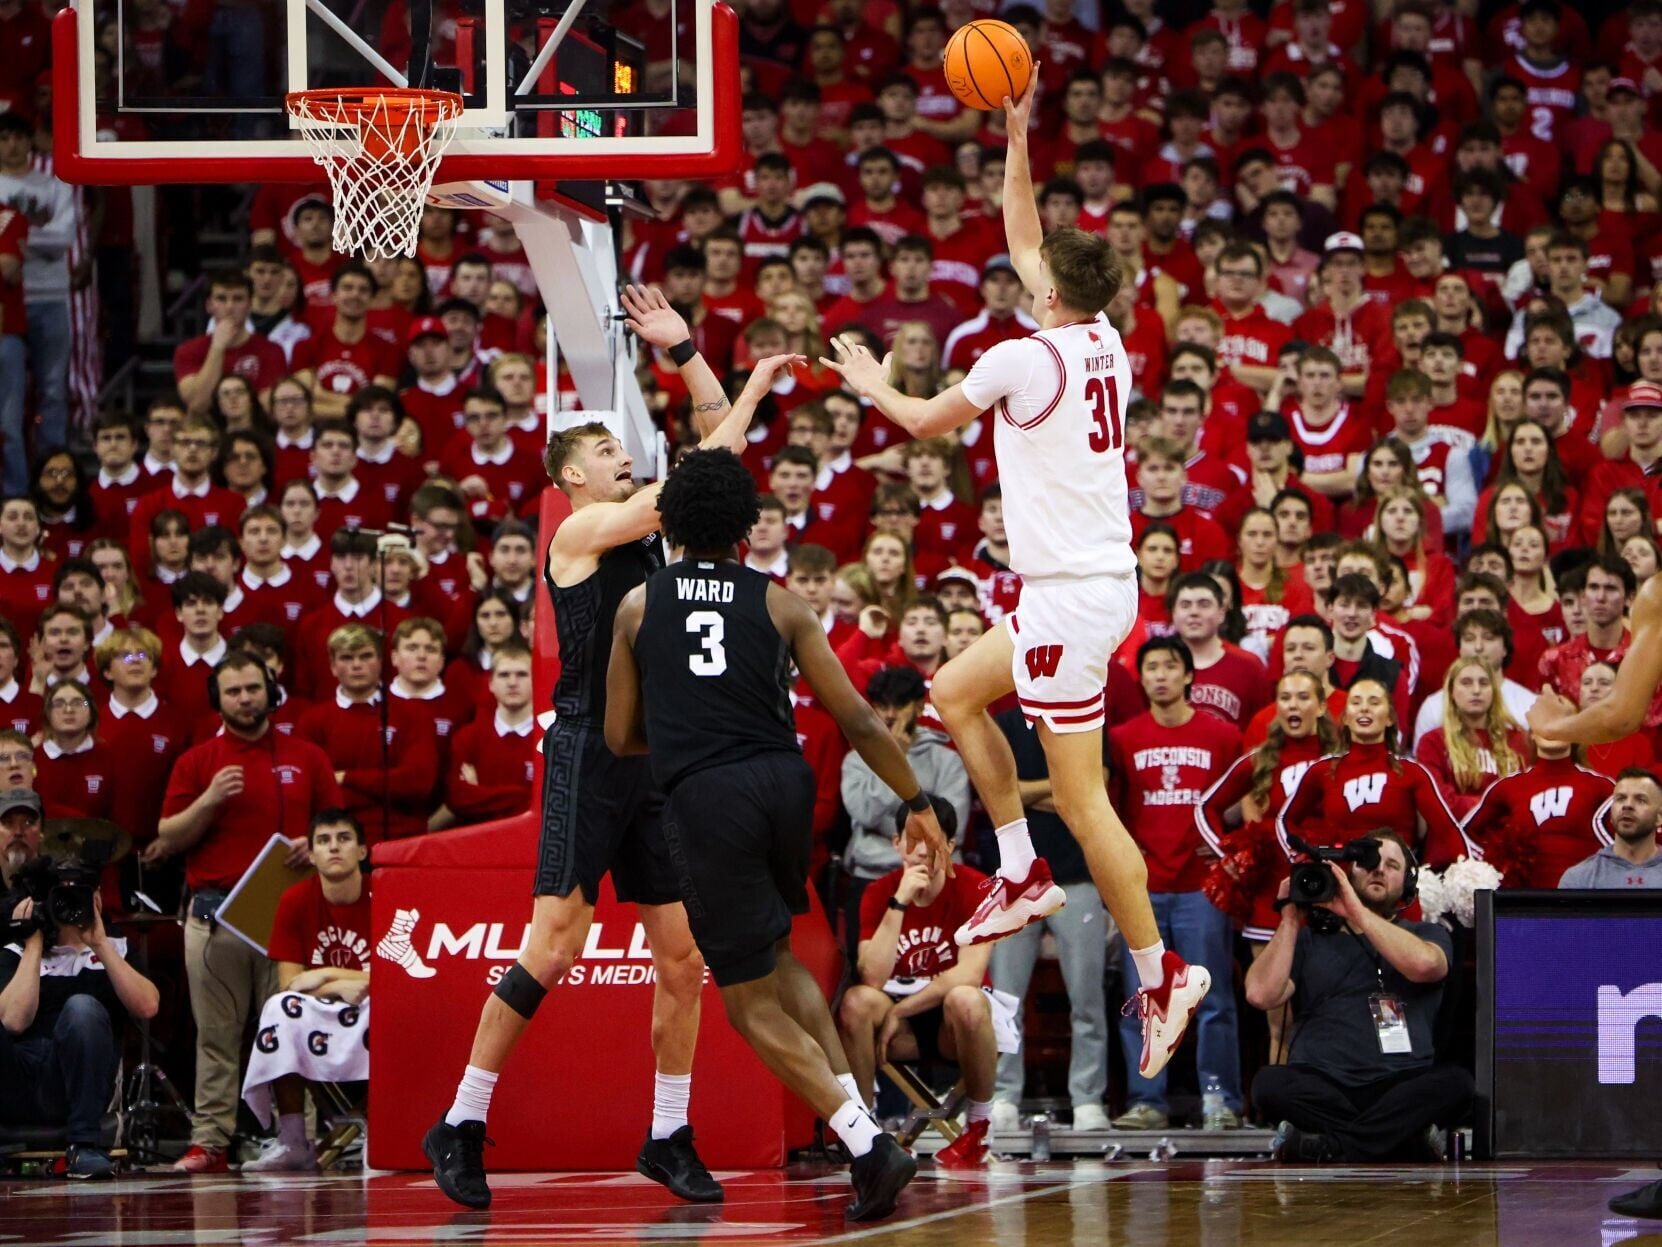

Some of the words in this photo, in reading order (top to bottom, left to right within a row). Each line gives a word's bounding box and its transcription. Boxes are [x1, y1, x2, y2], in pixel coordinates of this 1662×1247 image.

[1084, 354, 1114, 373] WINTER
[1085, 376, 1122, 453] 31
[676, 577, 735, 603] WARD
[685, 611, 728, 676] 3
[1025, 644, 1064, 682] W
[1133, 745, 1212, 771] WISCONSIN
[1343, 772, 1388, 813] W
[1529, 785, 1574, 827] W
